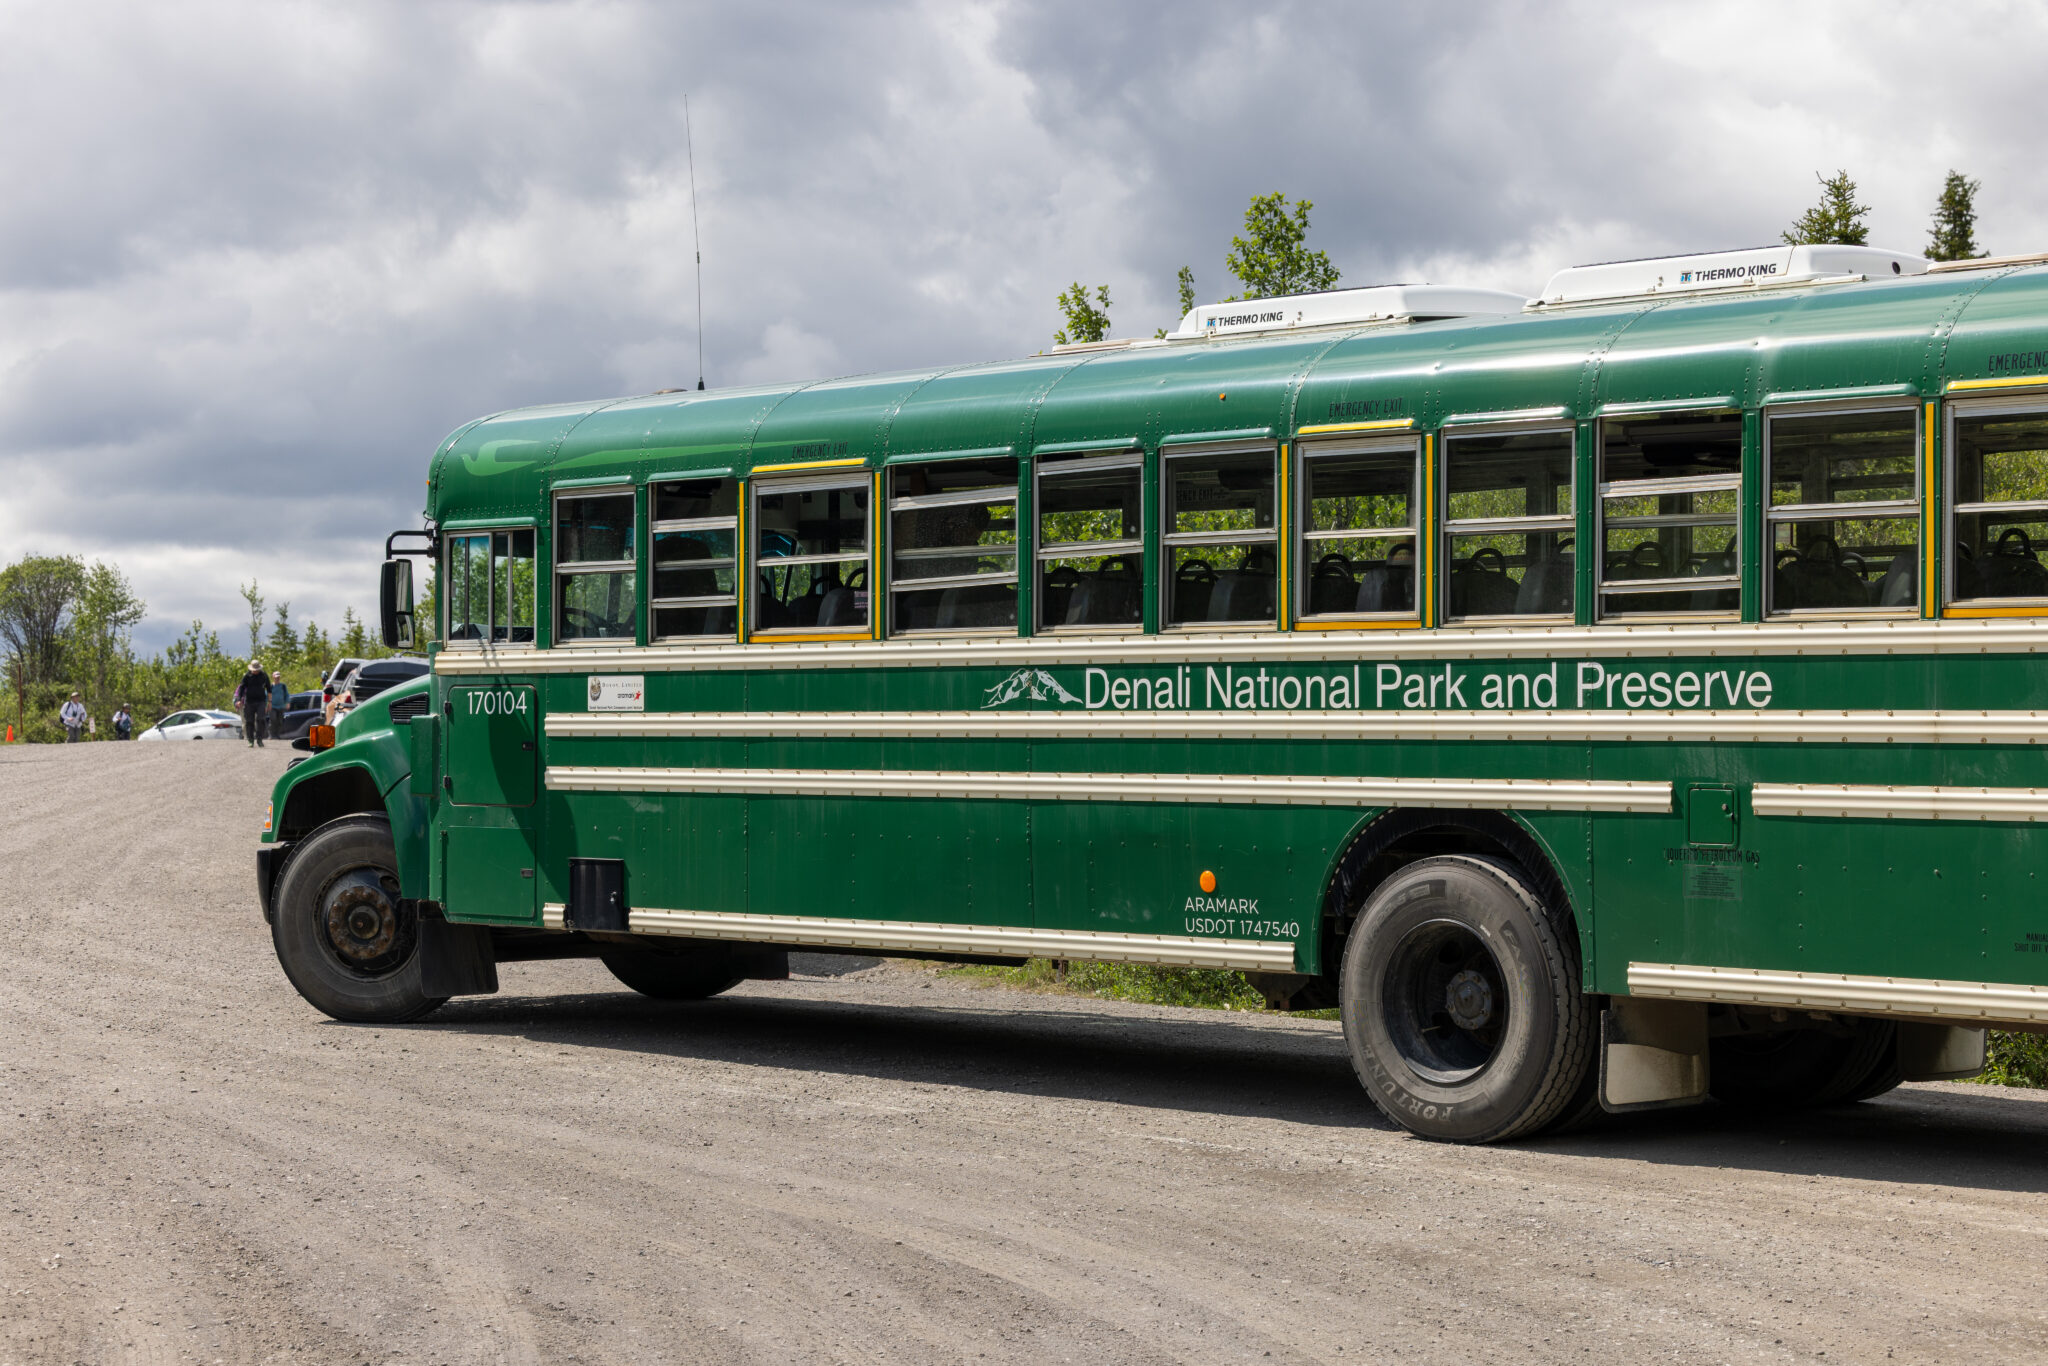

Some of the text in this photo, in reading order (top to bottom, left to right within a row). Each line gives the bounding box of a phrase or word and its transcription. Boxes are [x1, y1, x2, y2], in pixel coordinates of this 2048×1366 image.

[1695, 266, 1746, 282] THERMO
[1747, 263, 1777, 276] KING
[1218, 314, 1258, 327] THERMO
[1260, 311, 1283, 322] KING
[1328, 397, 1403, 417] EMERGENCY EXIT
[791, 442, 831, 459] EMERGENCY
[1084, 661, 1773, 709] Denali National Park and Preserve
[467, 691, 528, 715] 170104
[1745, 850, 1760, 863] GAS
[1184, 896, 1259, 915] ARAMARK
[1185, 917, 1300, 938] USDOT 1747540
[1361, 1043, 1454, 1121] FORTUNE
